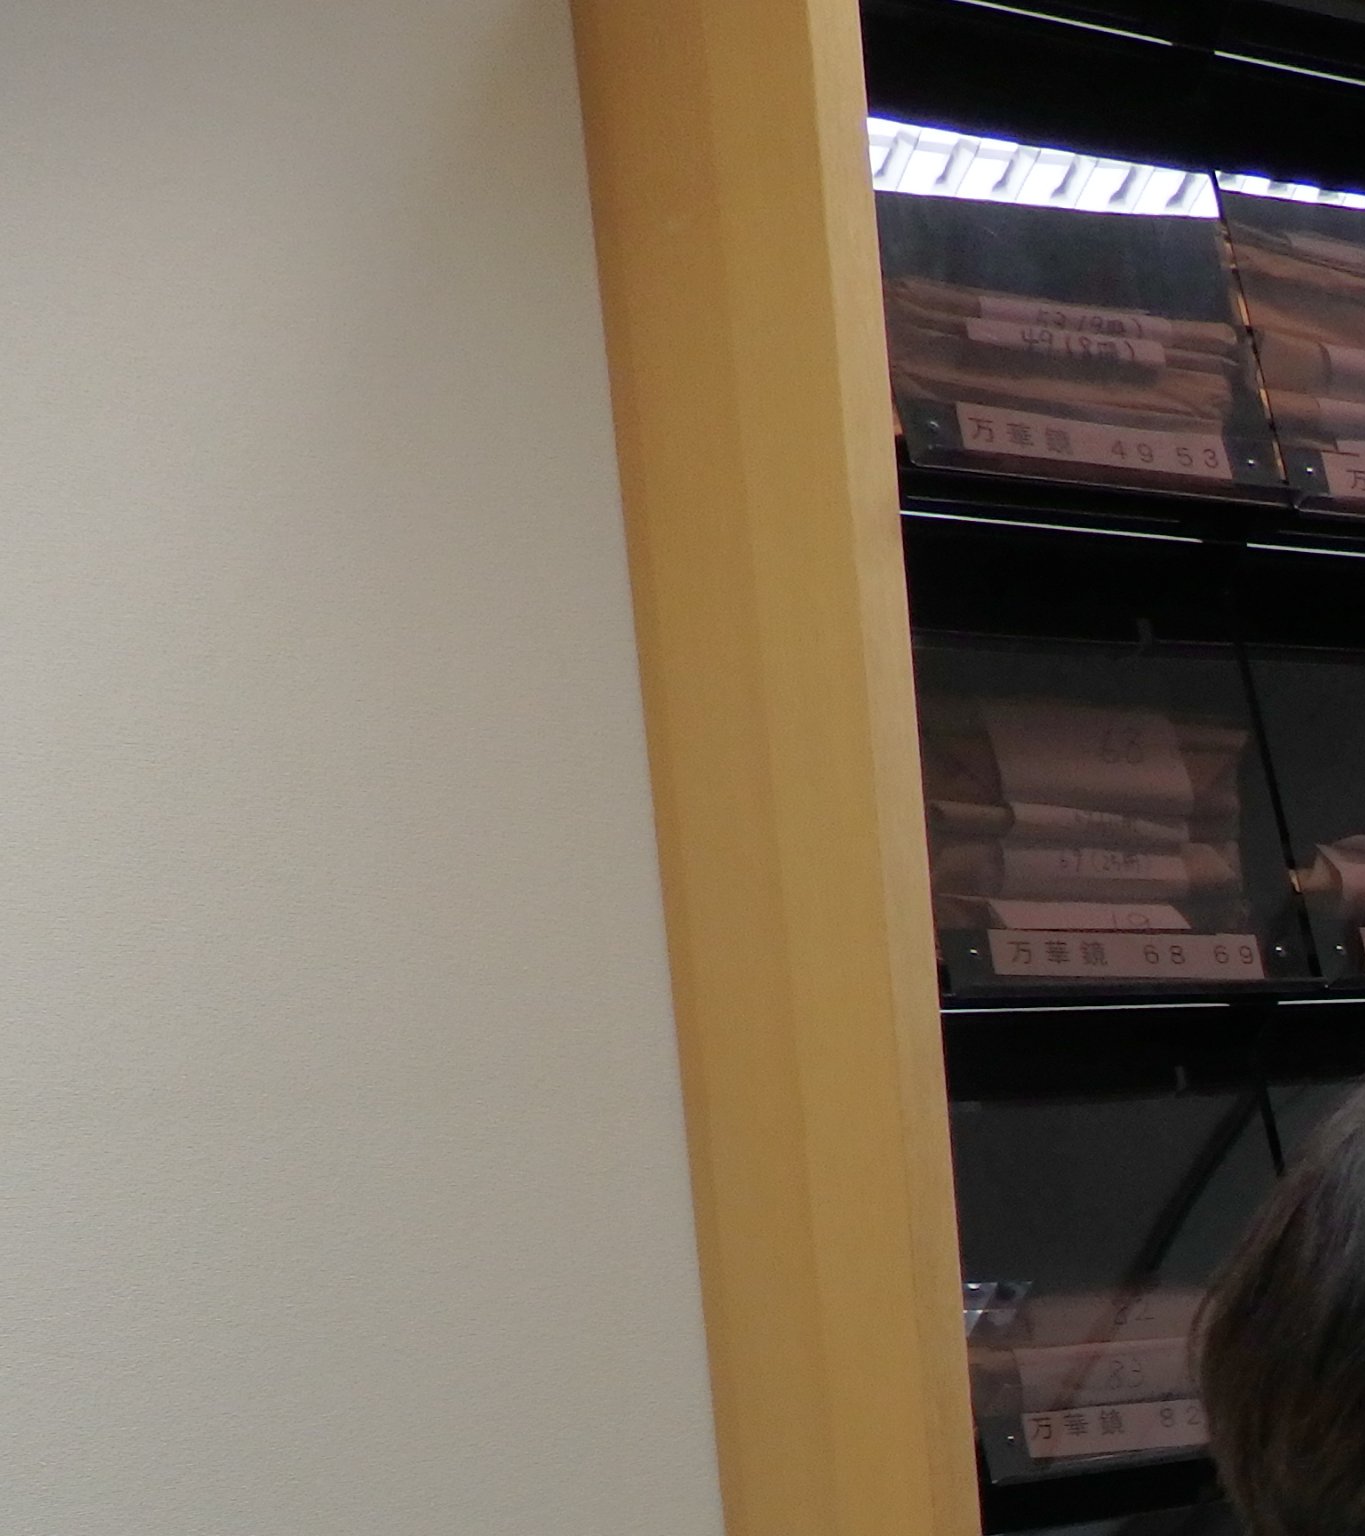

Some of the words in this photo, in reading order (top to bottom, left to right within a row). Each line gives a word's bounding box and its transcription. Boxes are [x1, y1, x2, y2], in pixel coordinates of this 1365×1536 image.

[1111, 440, 1154, 463] 49
[1176, 447, 1219, 469] 53
[1142, 944, 1186, 965] 68
[1213, 944, 1254, 965] 69
[1031, 1408, 1125, 1441] 万華鏡
[1159, 1404, 1201, 1429] 82
